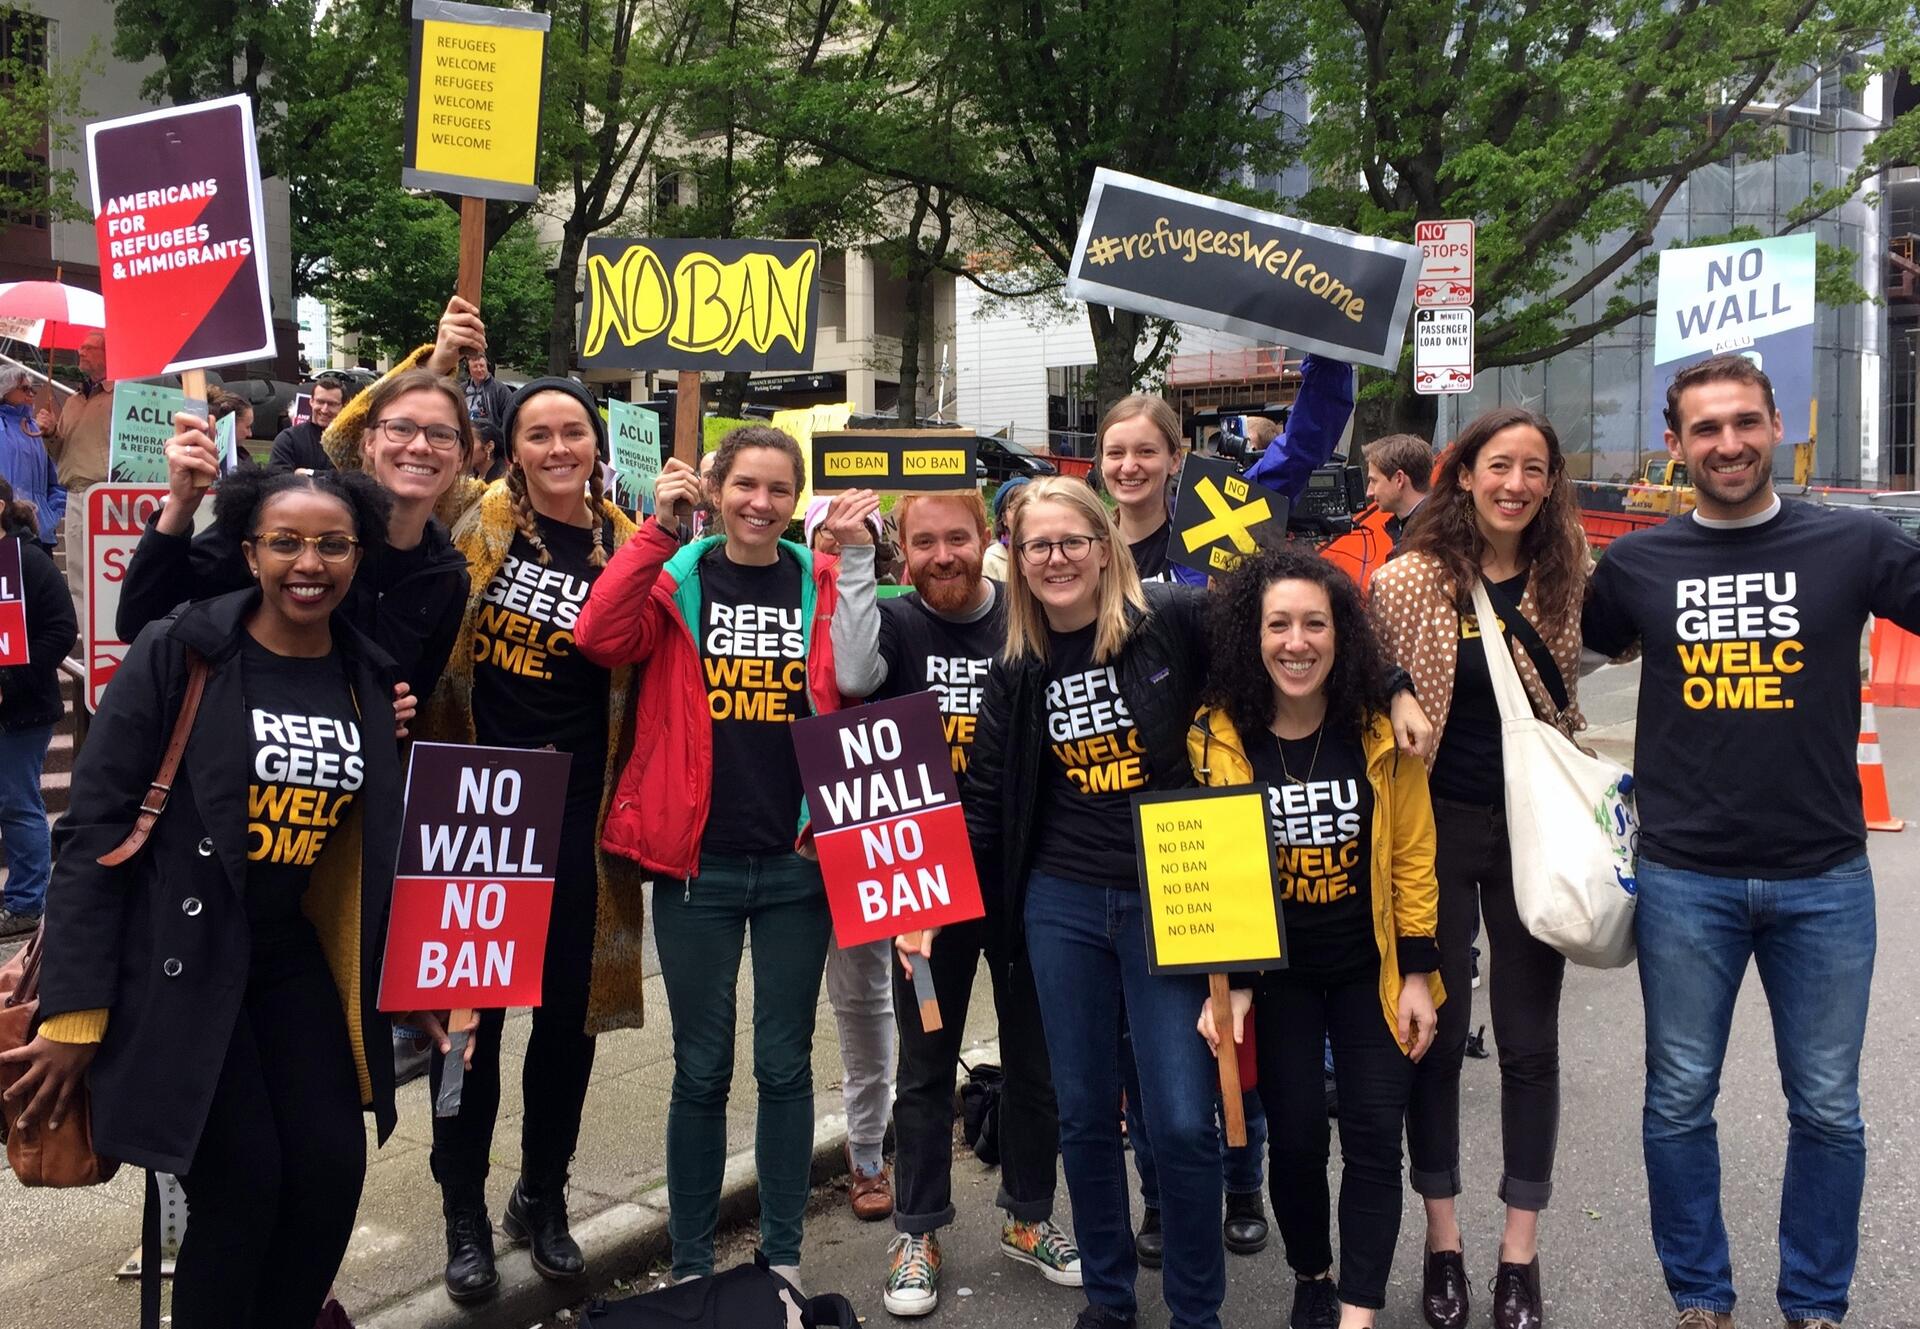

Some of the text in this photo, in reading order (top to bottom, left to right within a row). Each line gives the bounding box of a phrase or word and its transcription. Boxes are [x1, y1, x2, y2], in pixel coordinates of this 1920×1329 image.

[437, 36, 496, 54] REFUGEES
[436, 55, 497, 73] WELCOME
[434, 75, 494, 93] REFUGEES
[433, 94, 494, 112] WELCOME
[432, 113, 491, 131] REFUGEES
[431, 132, 492, 151] WELCOME
[106, 178, 218, 216] AMERICANS
[108, 215, 146, 237] FOR
[110, 223, 210, 259] REFUGEES
[1421, 224, 1443, 240] NO
[112, 237, 252, 280] & IMMIGRANTS
[1422, 243, 1469, 258] STOPS
[1086, 217, 1366, 323] #refugeesWelcome
[1707, 247, 1763, 293] NO
[583, 244, 816, 357] NO BAN
[1423, 311, 1431, 321] 3
[1676, 282, 1792, 340] WALL
[1420, 324, 1468, 335] PASSENGER
[1420, 336, 1468, 347] LOAD ONLY
[1715, 335, 1751, 352] ACLU
[118, 432, 166, 446] IMMIGRA
[120, 442, 166, 456] & REFUG
[619, 422, 653, 445] ACLU
[617, 447, 658, 466] IMMIGRANTS
[625, 458, 658, 474] REFUGEES
[830, 456, 884, 469] NO BAN
[905, 456, 959, 469] NO BAN
[1228, 481, 1246, 497] NO
[102, 494, 161, 531] NO
[501, 554, 590, 602] REFU
[1677, 572, 1797, 609] REFU
[482, 576, 582, 630] GEES
[709, 601, 803, 631] REFU
[476, 604, 576, 657] WELC
[1676, 604, 1801, 642] GEES
[706, 627, 805, 659] GEES
[1676, 639, 1806, 675] WELC
[703, 657, 806, 692] WELC
[707, 688, 796, 722] OME.
[928, 683, 984, 715] GEE
[1683, 676, 1795, 710] OME.
[252, 708, 361, 753] REFU
[1048, 697, 1135, 743] GEES
[838, 718, 903, 769] NO
[1051, 727, 1147, 767] WELC
[254, 744, 365, 792] GEES
[248, 784, 354, 827] WELC
[456, 766, 522, 816] NO
[818, 763, 946, 826] WALL
[1268, 778, 1359, 816] REFU
[1156, 819, 1203, 833] NO BAN
[1272, 812, 1361, 847] GEES
[420, 823, 543, 874] WALL
[860, 818, 924, 870] NO
[1158, 840, 1205, 854] NO BAN
[1277, 840, 1359, 878] WELC
[1161, 860, 1207, 874] NO BAN
[857, 863, 951, 923] BAN
[1163, 881, 1210, 895] NO BAN
[1279, 871, 1357, 904] OME.
[440, 883, 507, 930] NO
[1166, 902, 1212, 916] NO BAN
[1168, 922, 1215, 936] NO BAN
[416, 940, 515, 989] BAN
